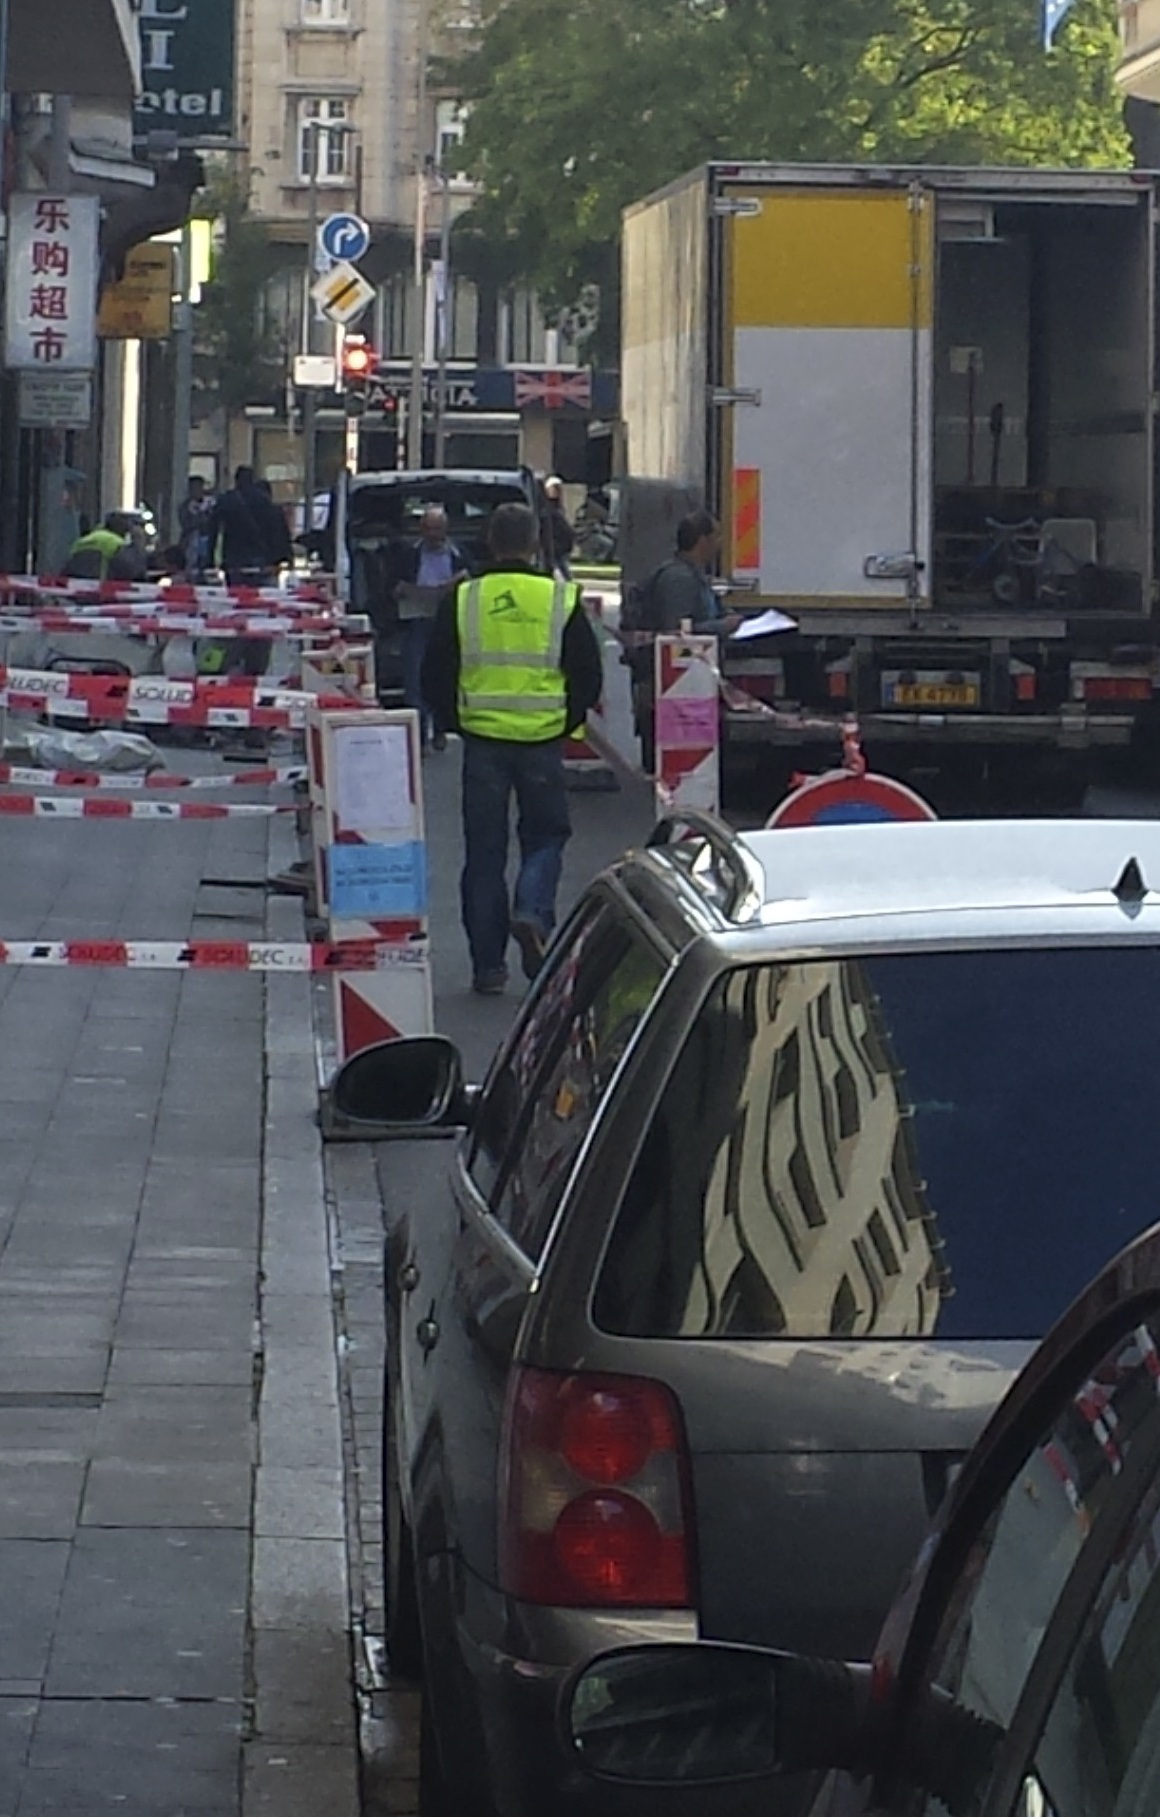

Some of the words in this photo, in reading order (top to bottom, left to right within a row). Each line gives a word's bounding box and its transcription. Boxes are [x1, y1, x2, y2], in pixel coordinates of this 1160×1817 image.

[134, 88, 222, 116] otel
[29, 198, 70, 364] 乐购超市
